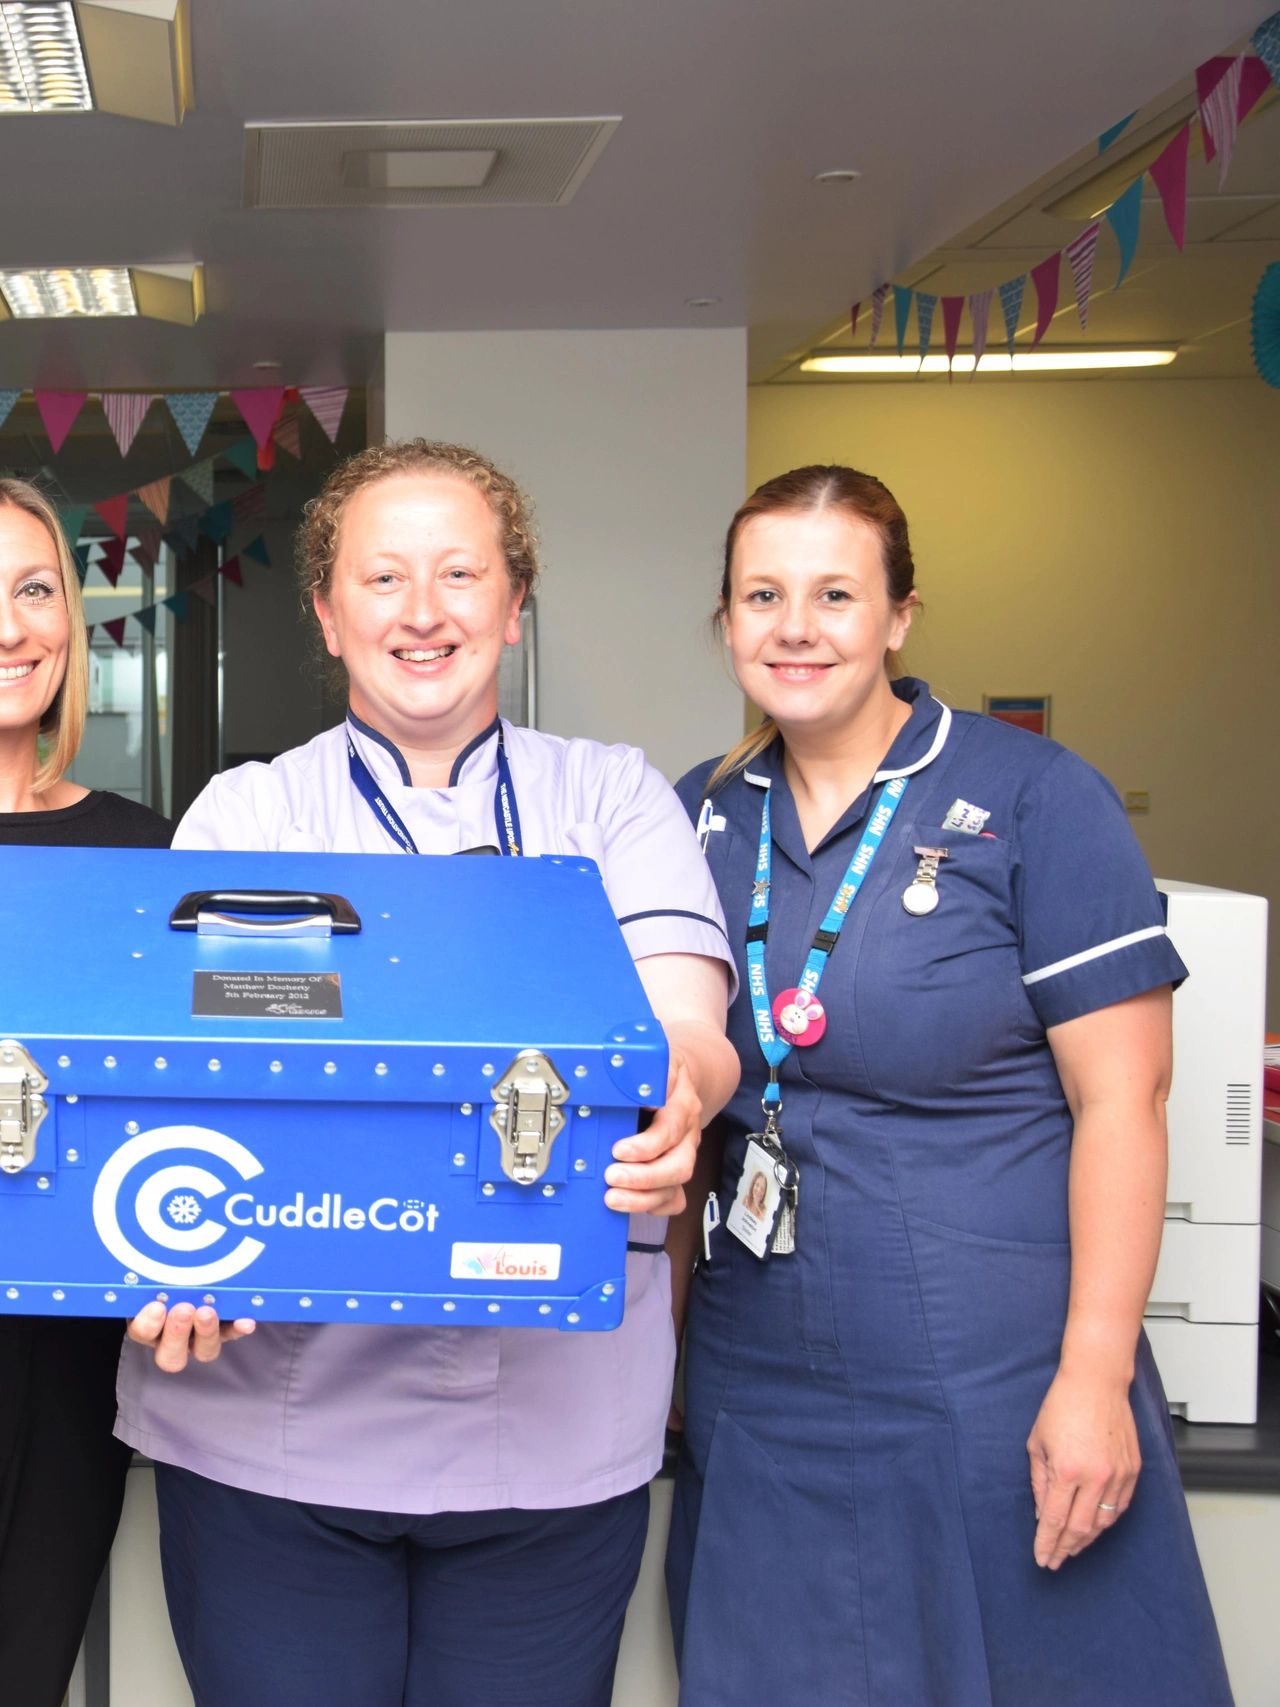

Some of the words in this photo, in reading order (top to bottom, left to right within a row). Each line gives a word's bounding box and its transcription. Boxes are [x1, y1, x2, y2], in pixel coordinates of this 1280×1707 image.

[886, 776, 908, 799] NH
[501, 794, 513, 827] NEWCASTLE
[869, 804, 892, 837] NHS
[758, 842, 769, 872] NHS
[851, 843, 875, 876] NHS
[751, 964, 765, 996] NHS
[800, 969, 819, 993] HS
[757, 1009, 775, 1042] NHS
[495, 1260, 548, 1276] Louis
